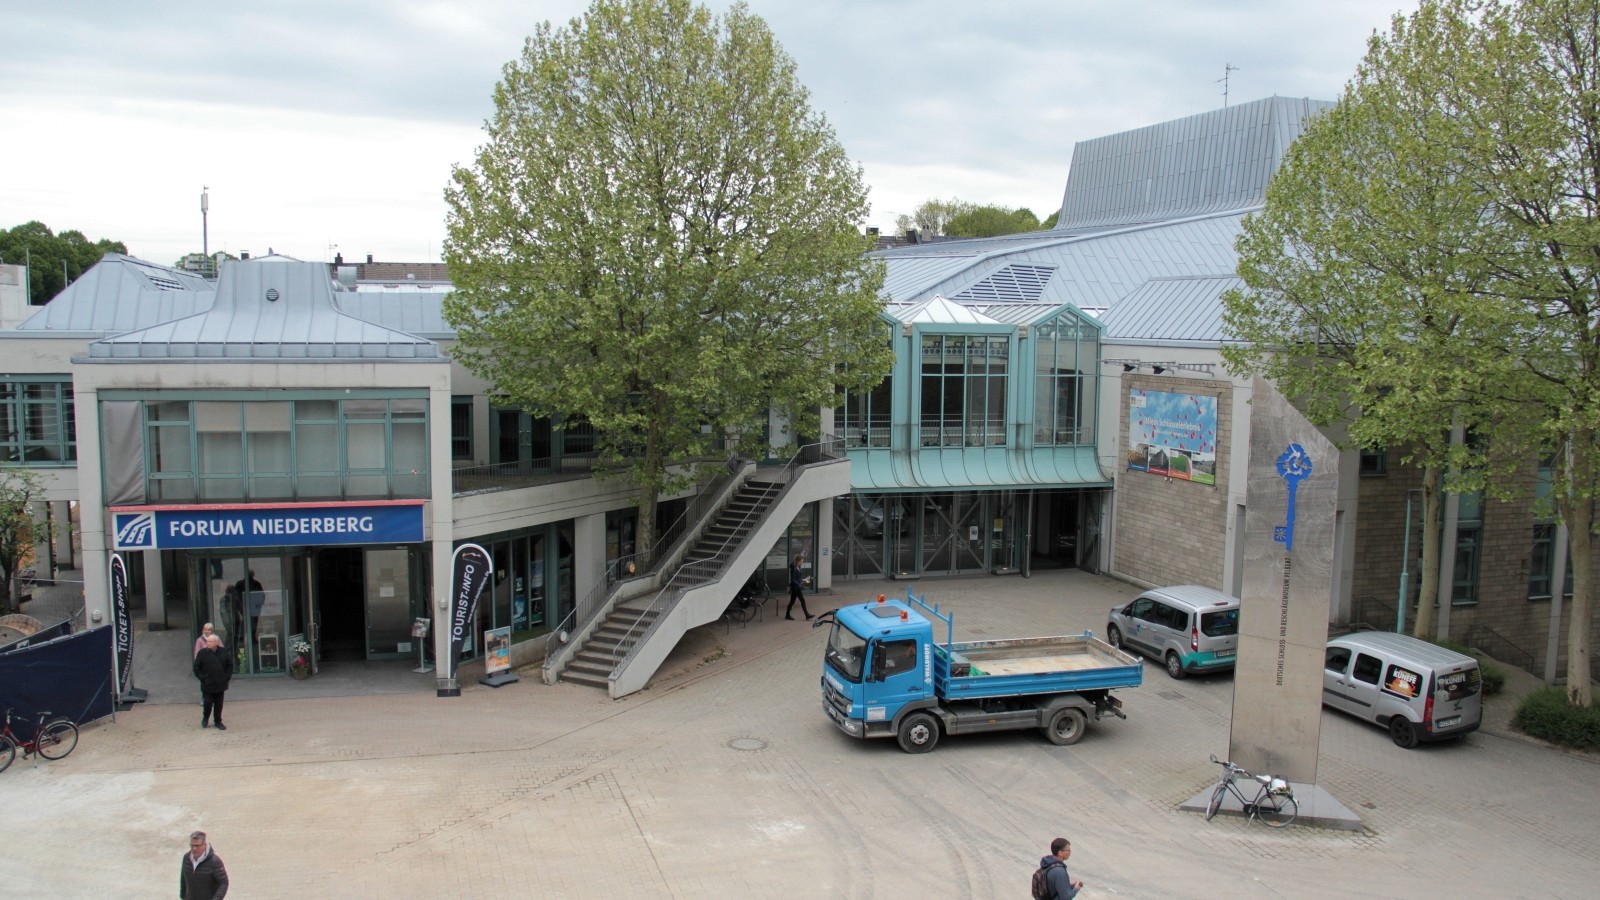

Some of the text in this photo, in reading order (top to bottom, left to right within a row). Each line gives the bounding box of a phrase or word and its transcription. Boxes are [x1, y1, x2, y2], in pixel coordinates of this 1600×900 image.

[169, 516, 374, 537] FORUM NIEDERBERG
[116, 575, 128, 653] TICKET-SHOP
[452, 564, 475, 642] TOURIST-INFO
[1276, 660, 1284, 686] DEUTSCHES
